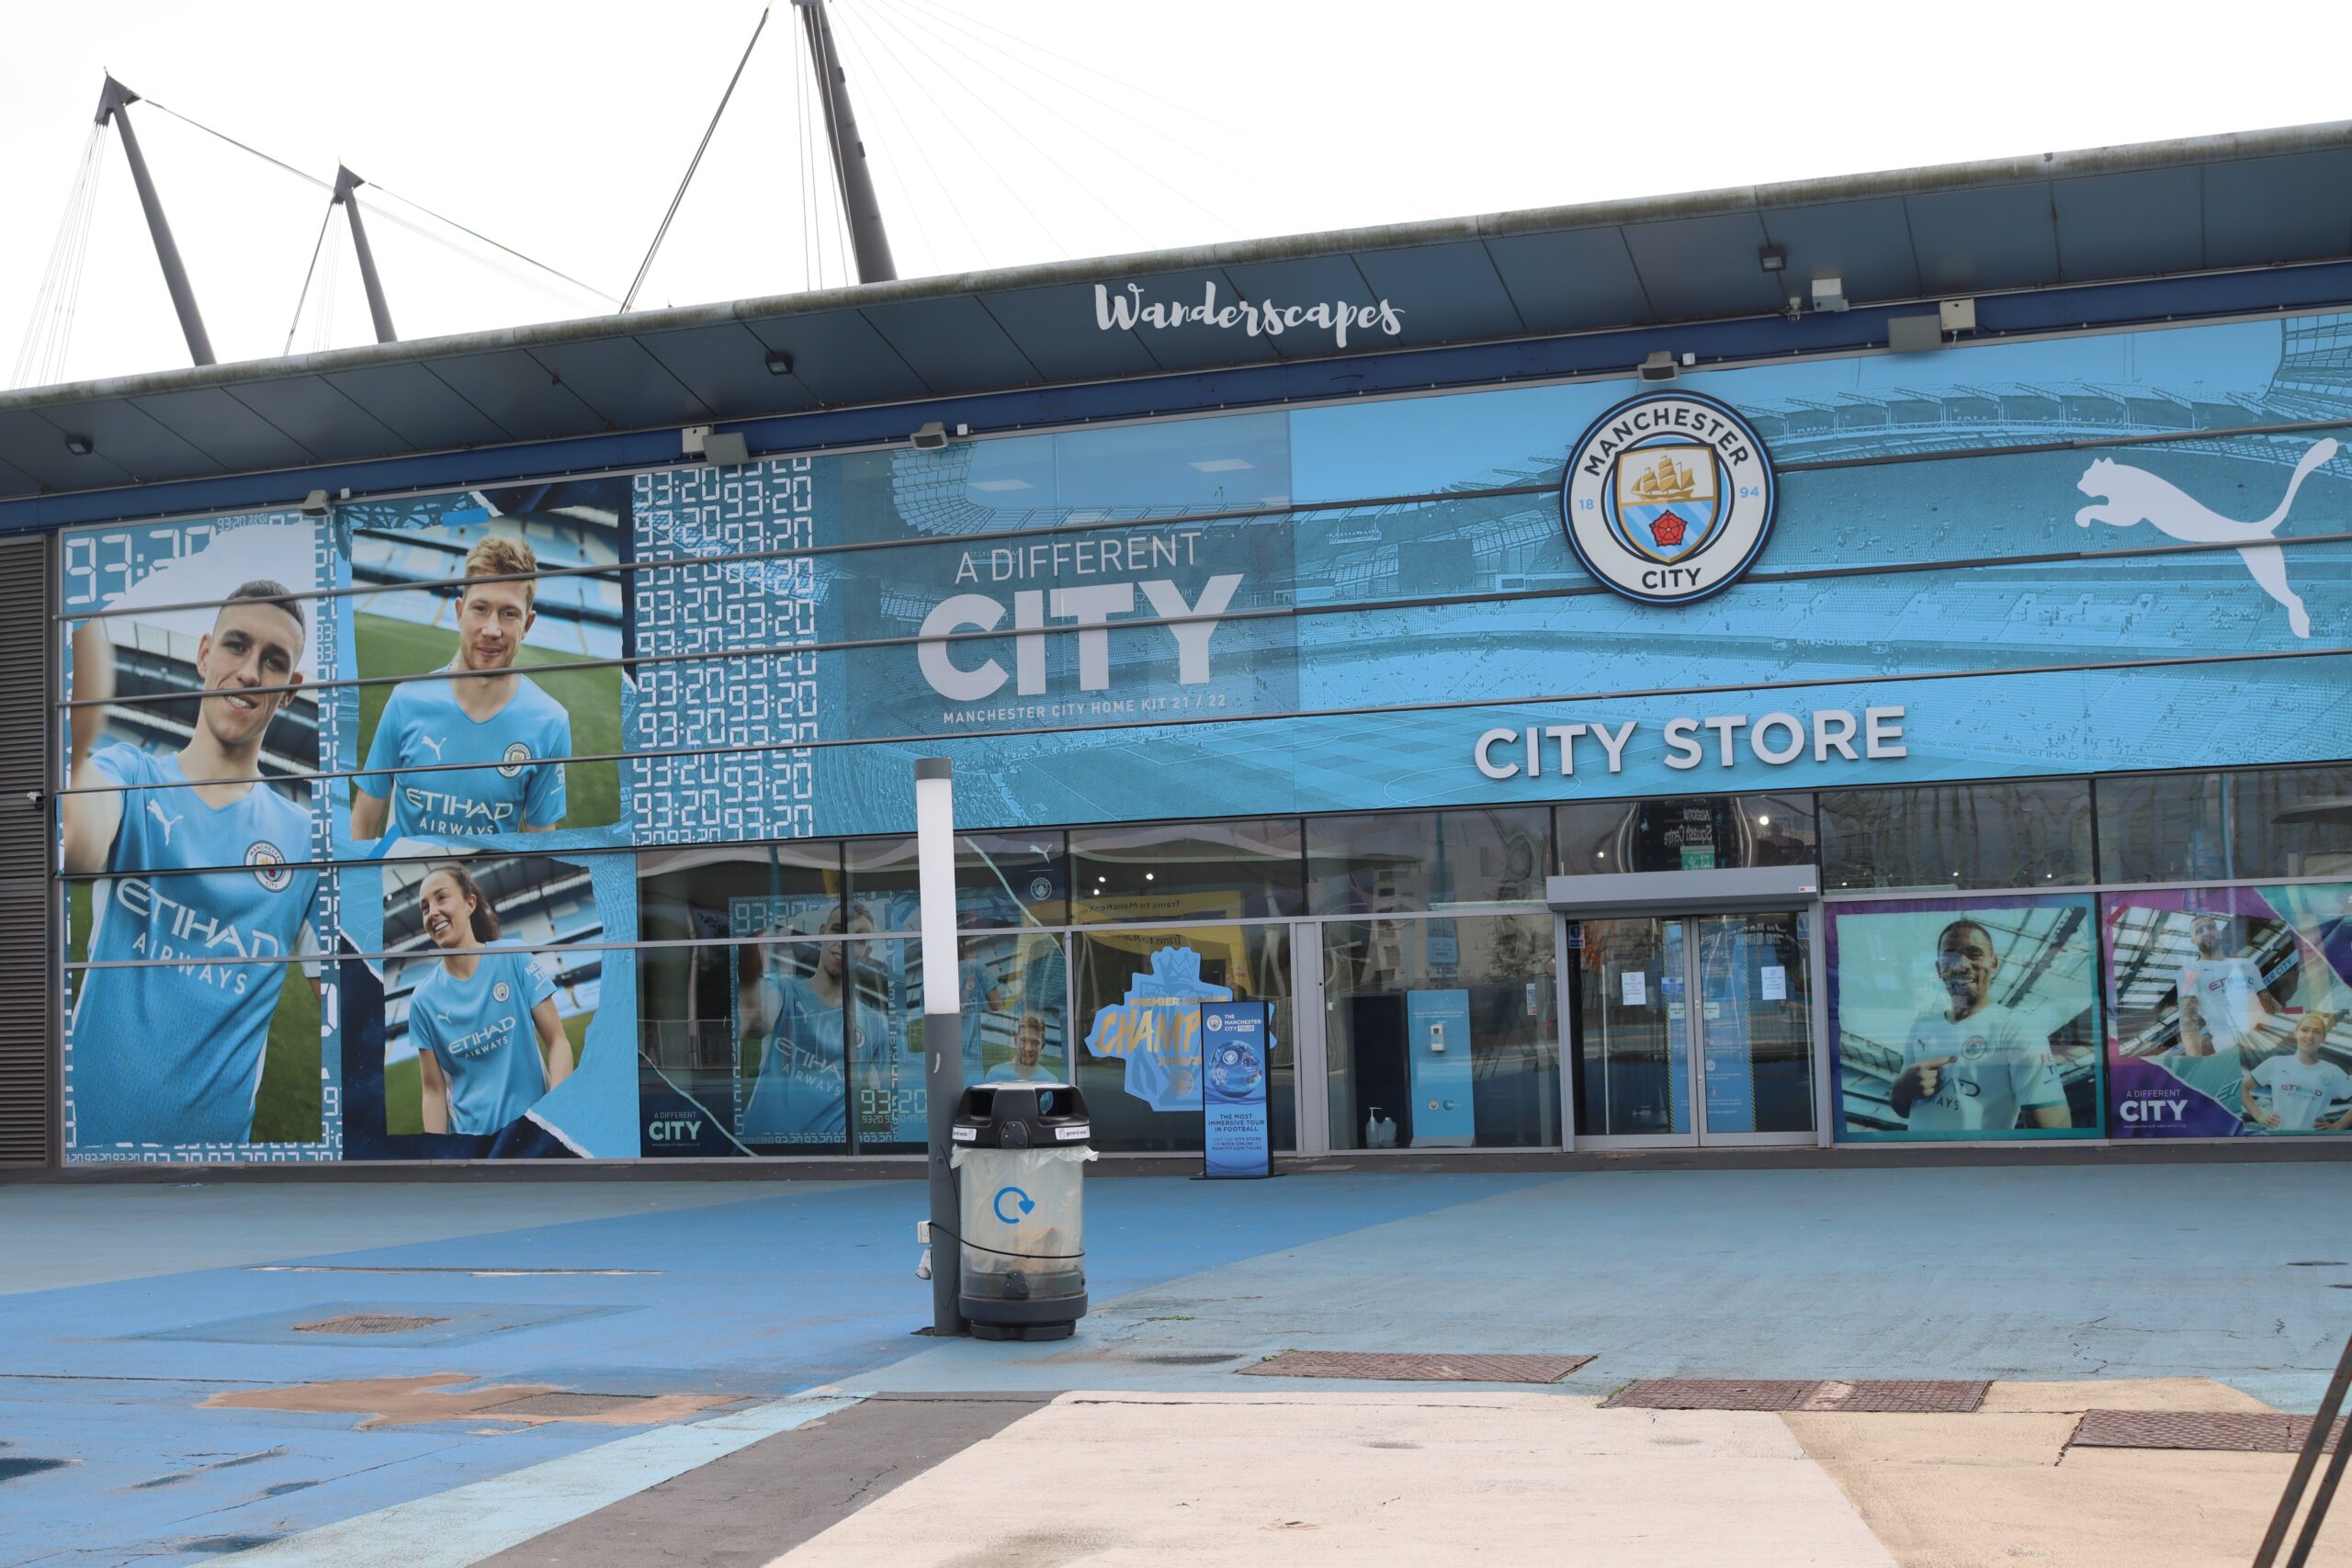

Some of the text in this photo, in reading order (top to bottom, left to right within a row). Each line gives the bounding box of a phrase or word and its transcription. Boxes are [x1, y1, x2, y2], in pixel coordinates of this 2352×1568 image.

[1584, 408, 1749, 476] MANCHESTER
[1578, 499, 1595, 511] 18
[1739, 486, 1760, 498] 94
[956, 532, 1202, 584] A DIFFERENT
[1641, 567, 1702, 590] CITY
[917, 573, 1244, 701] CITY
[943, 706, 1046, 725] MANCHESTER
[1052, 703, 1085, 718] CITY
[1091, 699, 1135, 714] HOME
[1141, 697, 1167, 710] KIT
[1172, 696, 1189, 709] 21
[1208, 694, 1227, 707] 22
[1474, 705, 1908, 780] CITY STORE
[406, 786, 514, 821] ETIHAD
[419, 817, 495, 837] AIRWAYS
[116, 877, 280, 967] ETIHAD
[132, 931, 248, 995] AIRWAYS
[447, 1016, 516, 1055] ETIHAD
[465, 1035, 509, 1059] AIRWAYS
[1094, 1008, 1201, 1055] CHAMP
[775, 1037, 844, 1082] ETIHA
[782, 1064, 842, 1097] AIRWAYS
[2125, 1089, 2181, 1098] A DIFFERENT
[2119, 1099, 2188, 1122] CITY
[649, 1121, 702, 1141] CITY
